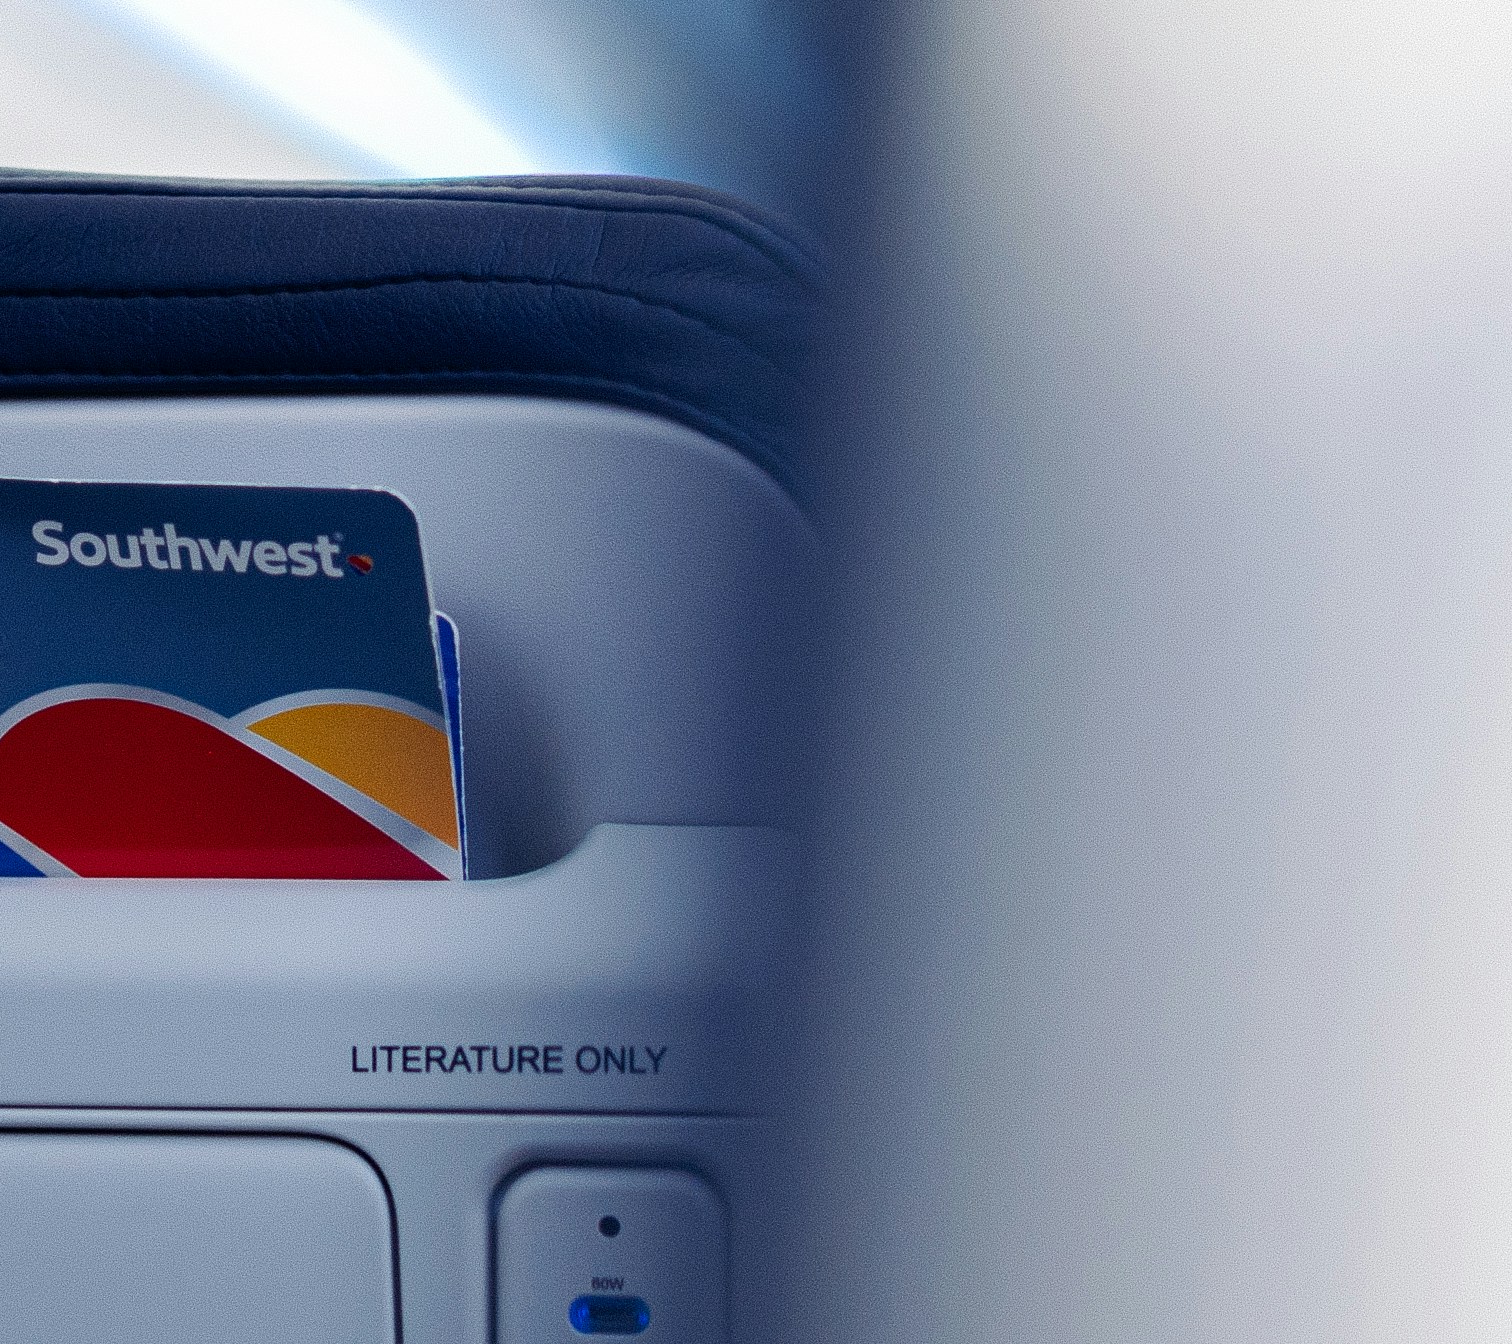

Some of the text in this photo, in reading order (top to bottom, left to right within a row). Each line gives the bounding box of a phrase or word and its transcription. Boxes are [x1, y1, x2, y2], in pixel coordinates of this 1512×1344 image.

[32, 520, 343, 578] Southwest
[351, 1045, 668, 1074] LITERATURE ONLY
